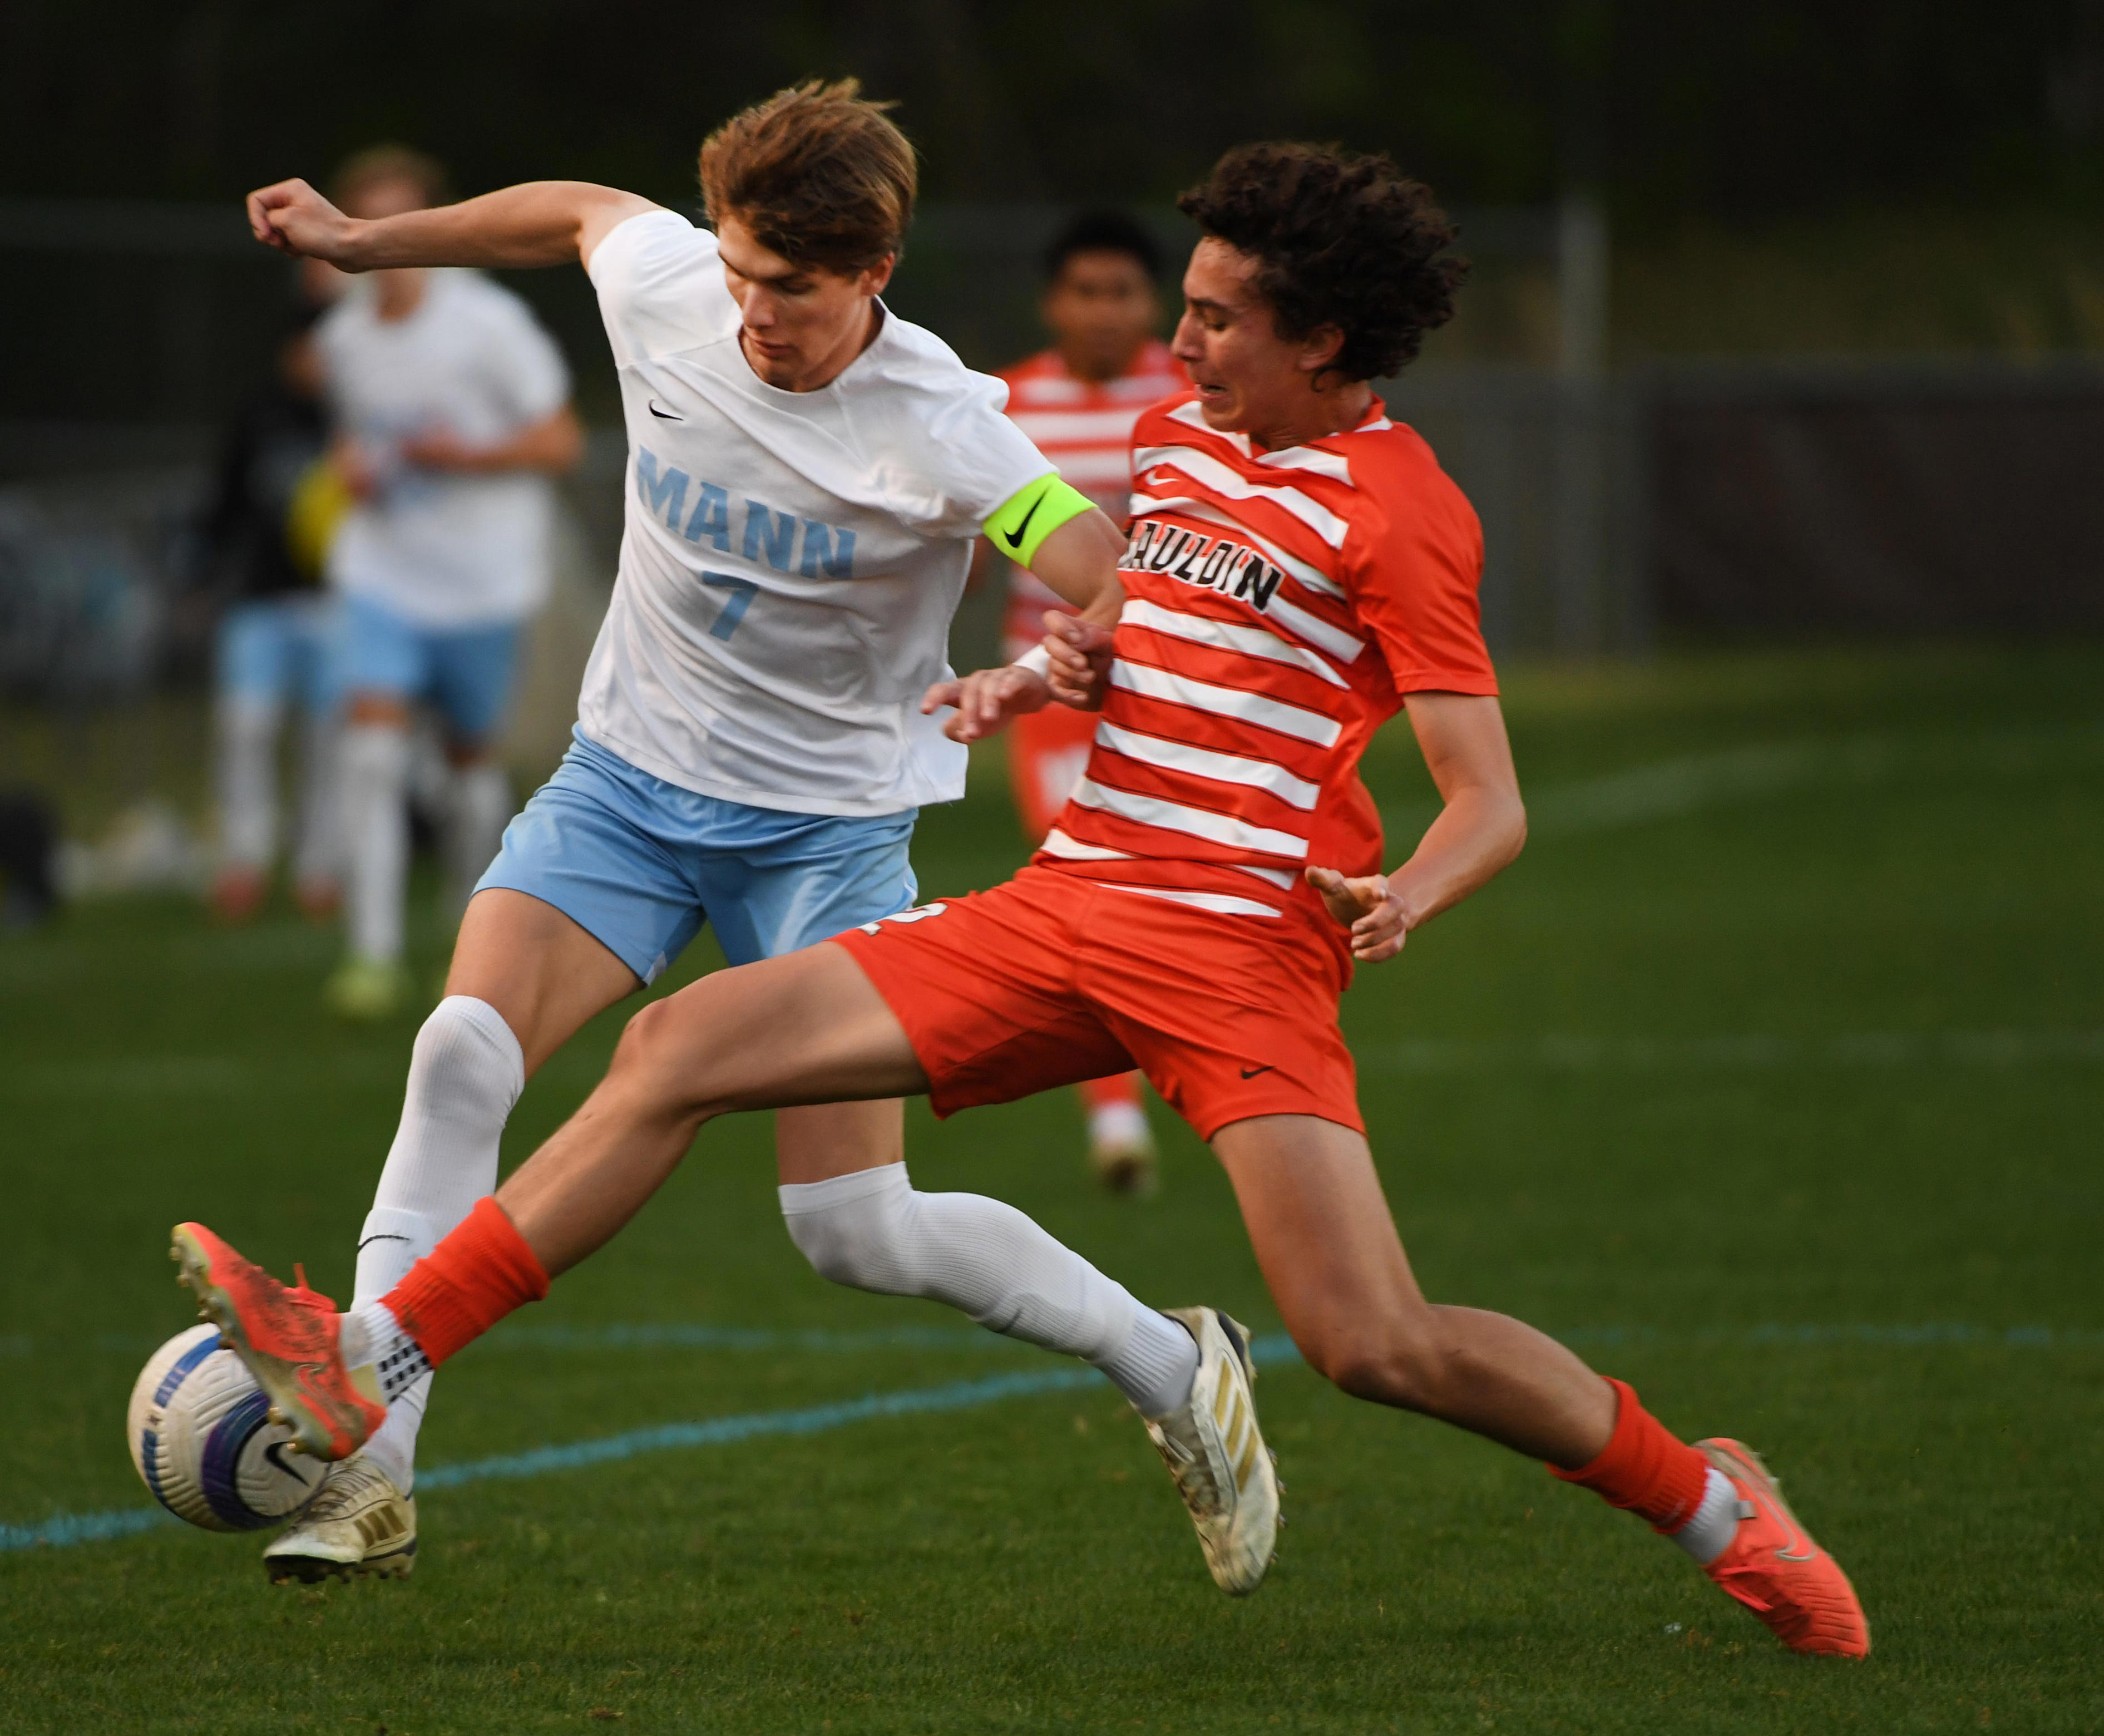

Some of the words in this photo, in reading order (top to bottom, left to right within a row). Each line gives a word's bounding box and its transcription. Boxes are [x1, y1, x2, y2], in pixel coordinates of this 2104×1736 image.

[638, 445, 856, 580] MANN
[702, 570, 758, 642] 7
[1118, 519, 1286, 614] AULDIN
